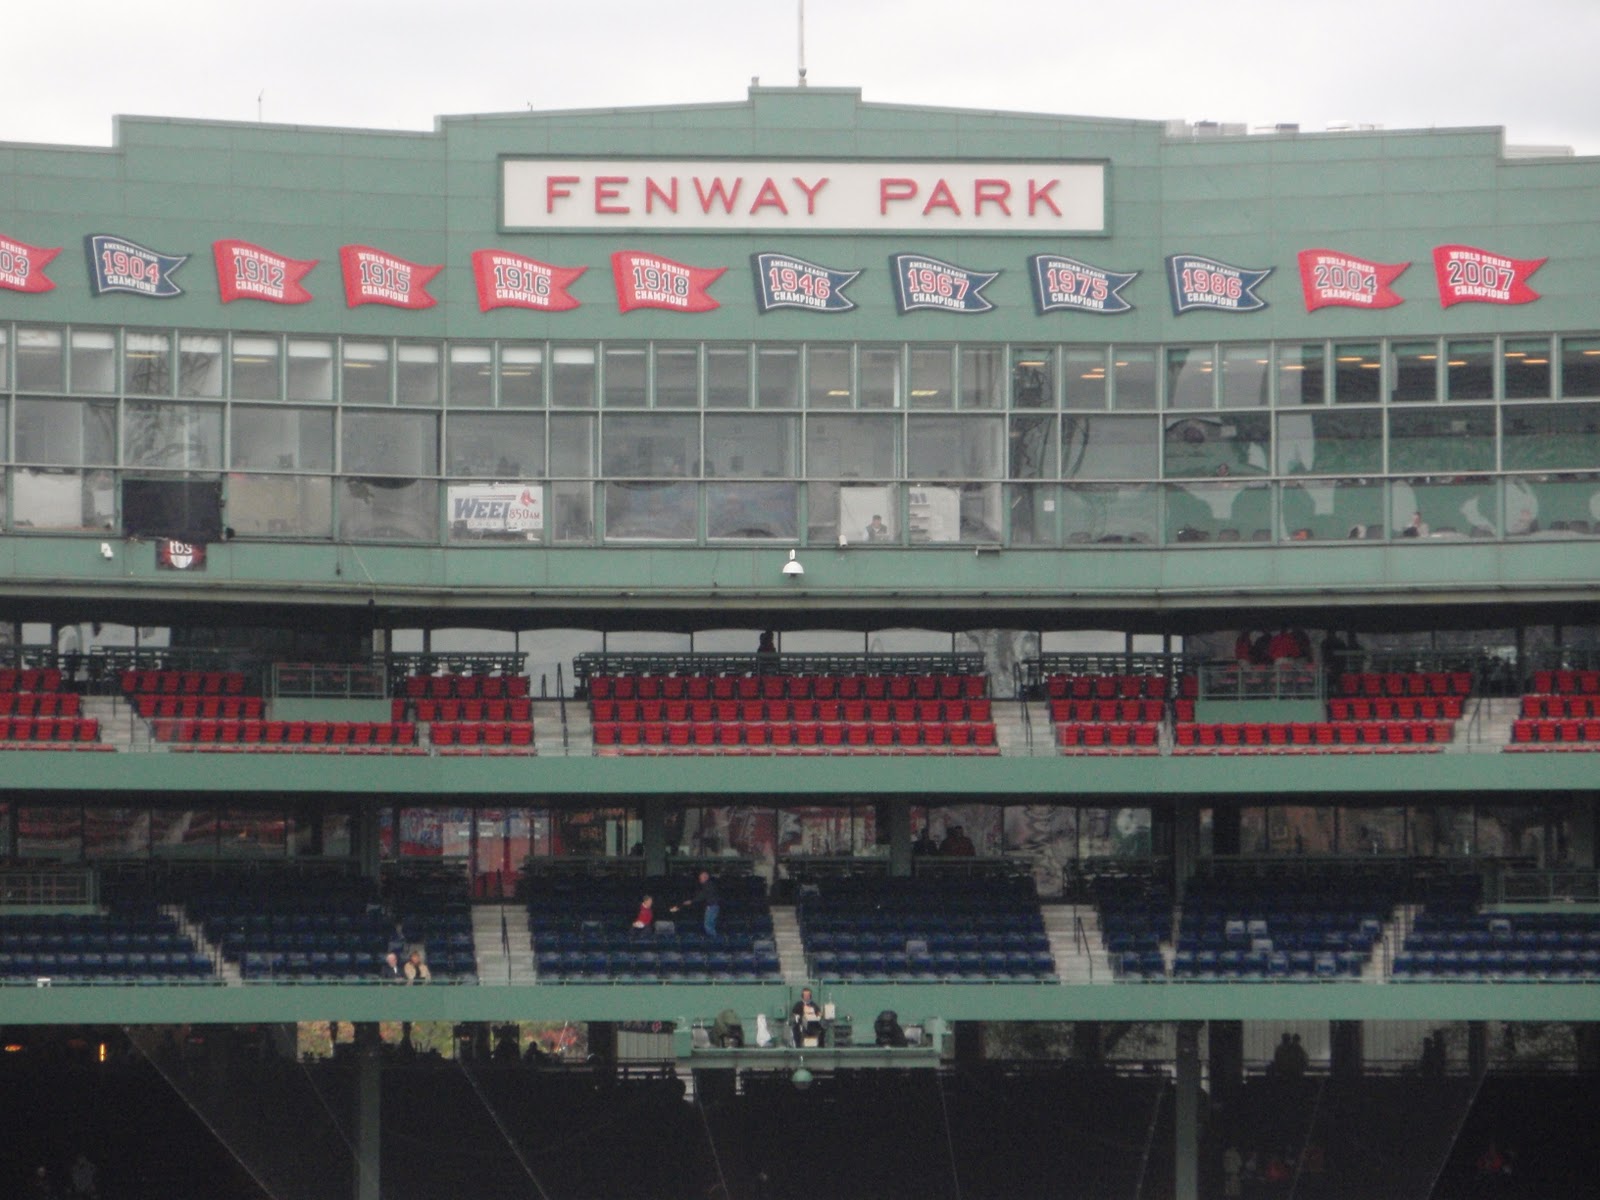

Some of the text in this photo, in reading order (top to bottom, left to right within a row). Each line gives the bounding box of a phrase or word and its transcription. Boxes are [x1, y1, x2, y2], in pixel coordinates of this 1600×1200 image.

[546, 176, 1062, 216] FENWAY PARK
[104, 242, 158, 262] AMERICAN LEAGUE
[232, 247, 285, 268] WORLD SERIES
[1450, 251, 1511, 269] WORLD SERIES
[103, 250, 159, 285] 1904
[358, 253, 411, 273] WORLD SERIES
[493, 256, 551, 276] WORLD SERIES
[631, 258, 689, 276] WORLD SERIES
[771, 260, 828, 278] AMERICAN LEAGUE
[910, 262, 967, 279] AMERICAN LEAGUE
[1049, 262, 1106, 279] AMERICAN LEAGUE
[1184, 262, 1240, 277] AMERICAN LEAGUE
[1317, 257, 1374, 273] WORLD SERIES
[234, 256, 285, 289] 1912
[360, 261, 411, 294] 1915
[494, 267, 550, 296] 1916
[1315, 265, 1377, 295] 2004
[1447, 261, 1514, 291] 2007
[107, 275, 156, 293] CHAMPIONS
[236, 281, 283, 298] CHAMPIONS
[633, 267, 688, 297] 1918
[769, 268, 830, 299] 1946
[908, 269, 969, 300] 1967
[1047, 269, 1108, 300] 1975
[1183, 269, 1242, 299] 1986
[362, 285, 408, 302] CHAMPIONS
[496, 289, 549, 305] CHAMPIONS
[635, 290, 688, 306] CHAMPIONS
[774, 291, 826, 307] CHAMPIONS
[913, 292, 965, 309] CHAMPIONS
[1052, 293, 1104, 308] CHAMPIONS
[1187, 292, 1237, 307] CHAMPIONS
[1321, 288, 1372, 304] CHAMPIONS
[1455, 284, 1510, 300] CHAMPIONS
[454, 498, 511, 519] WEEI
